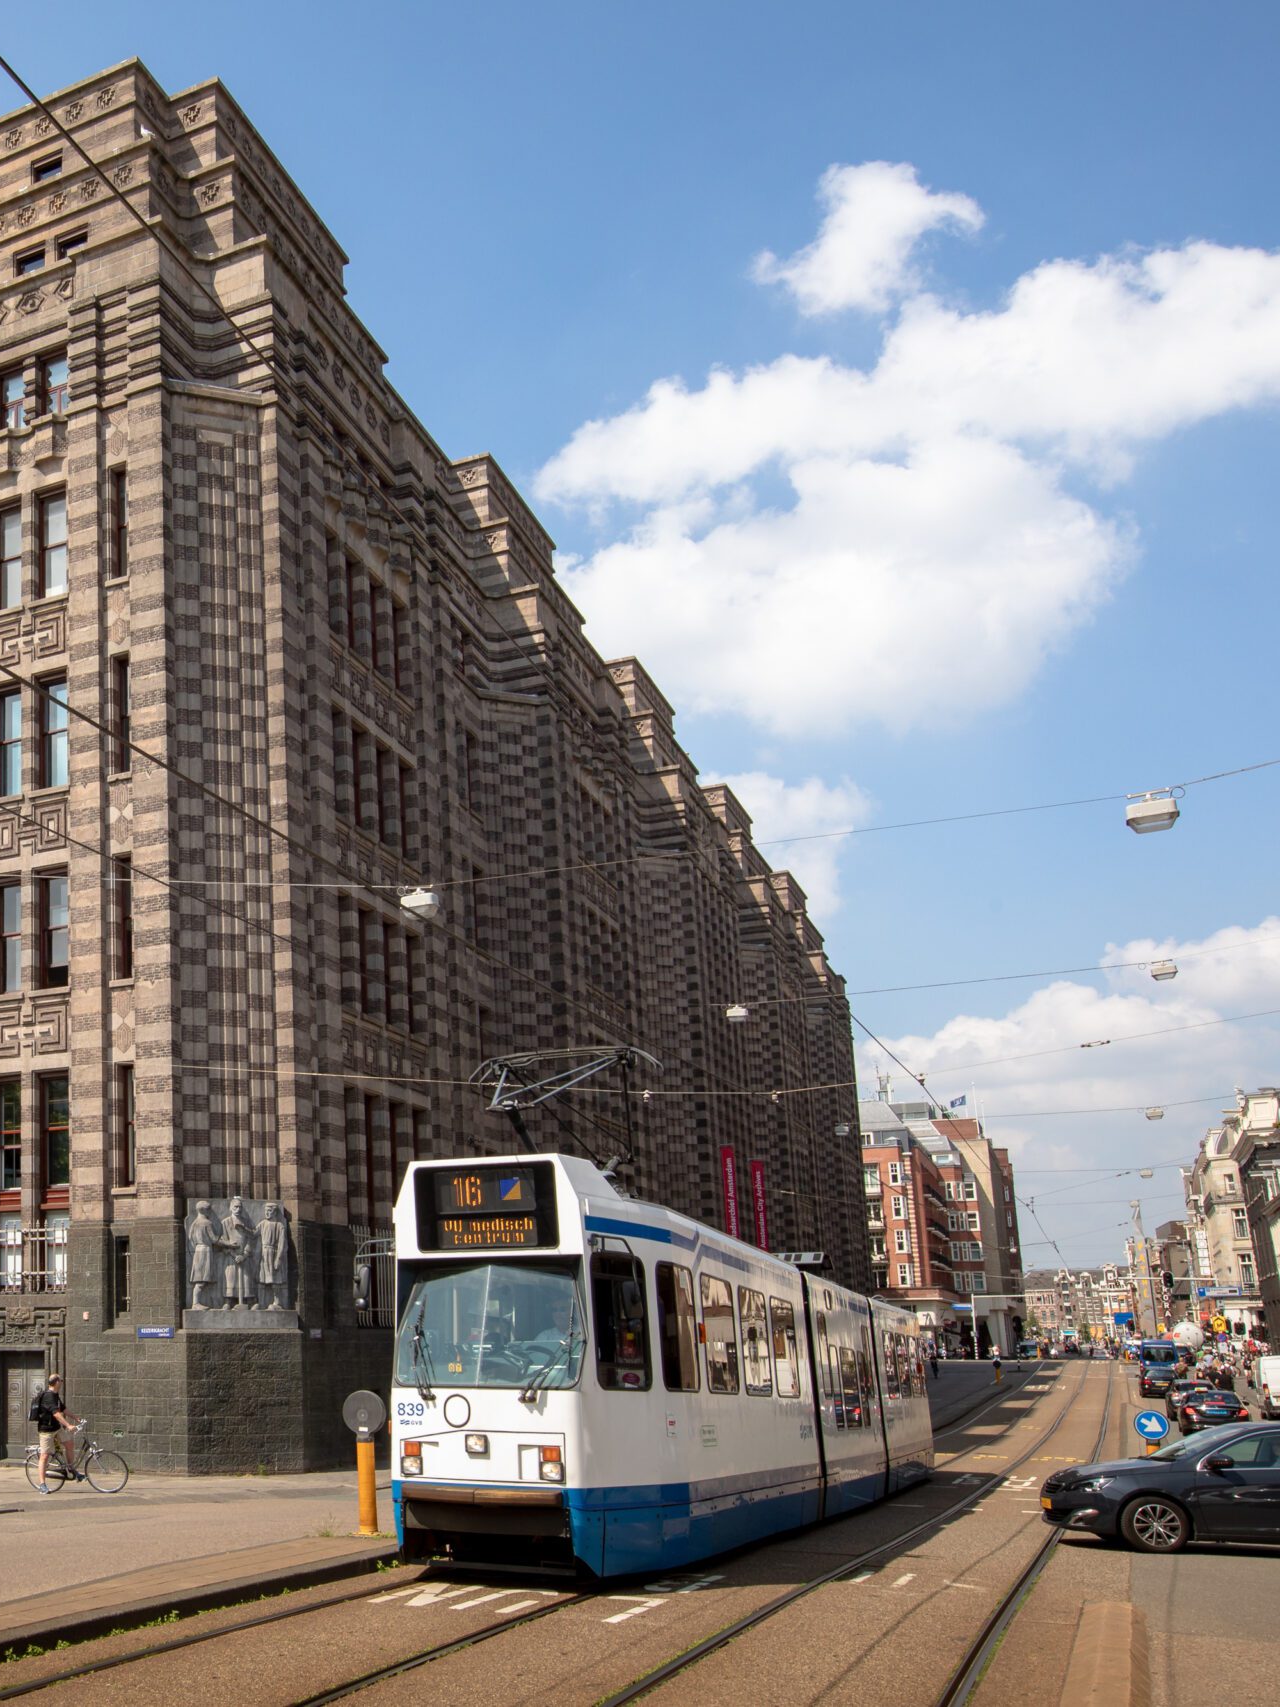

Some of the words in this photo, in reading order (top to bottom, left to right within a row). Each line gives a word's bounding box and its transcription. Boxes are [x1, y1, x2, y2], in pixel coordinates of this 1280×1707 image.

[726, 1157, 735, 1198] Amsterdam
[755, 1171, 763, 1197] Archives
[453, 1176, 481, 1207] 16
[757, 1199, 765, 1212] City
[468, 1217, 533, 1232] medisch
[728, 1199, 737, 1238] tadsarchief
[759, 1212, 767, 1248] Amsterdam
[454, 1231, 524, 1245] centrum
[7, 1326, 36, 1335] SAFE
[0, 1335, 43, 1344] DEPOSIT
[397, 1402, 424, 1416] 839
